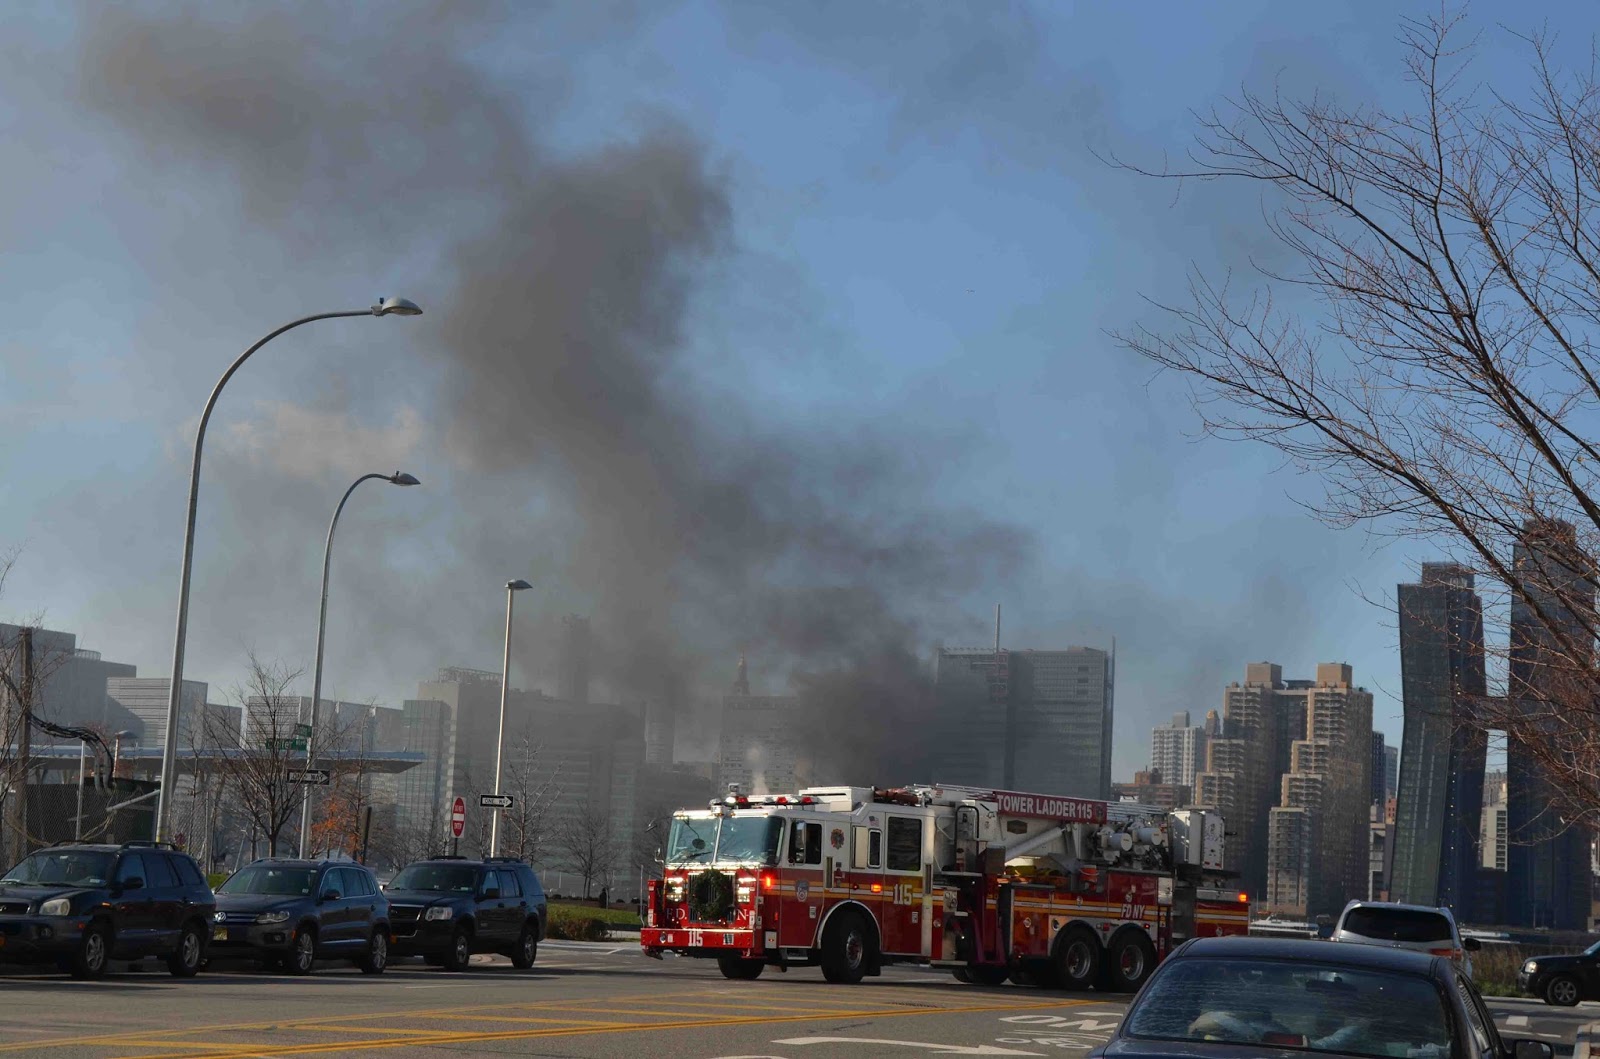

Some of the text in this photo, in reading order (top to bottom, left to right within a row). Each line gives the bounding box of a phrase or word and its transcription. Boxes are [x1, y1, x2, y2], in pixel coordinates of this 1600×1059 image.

[997, 795, 1093, 819] TOWER LADDER 115
[893, 884, 912, 905] 115
[687, 931, 704, 947] 115
